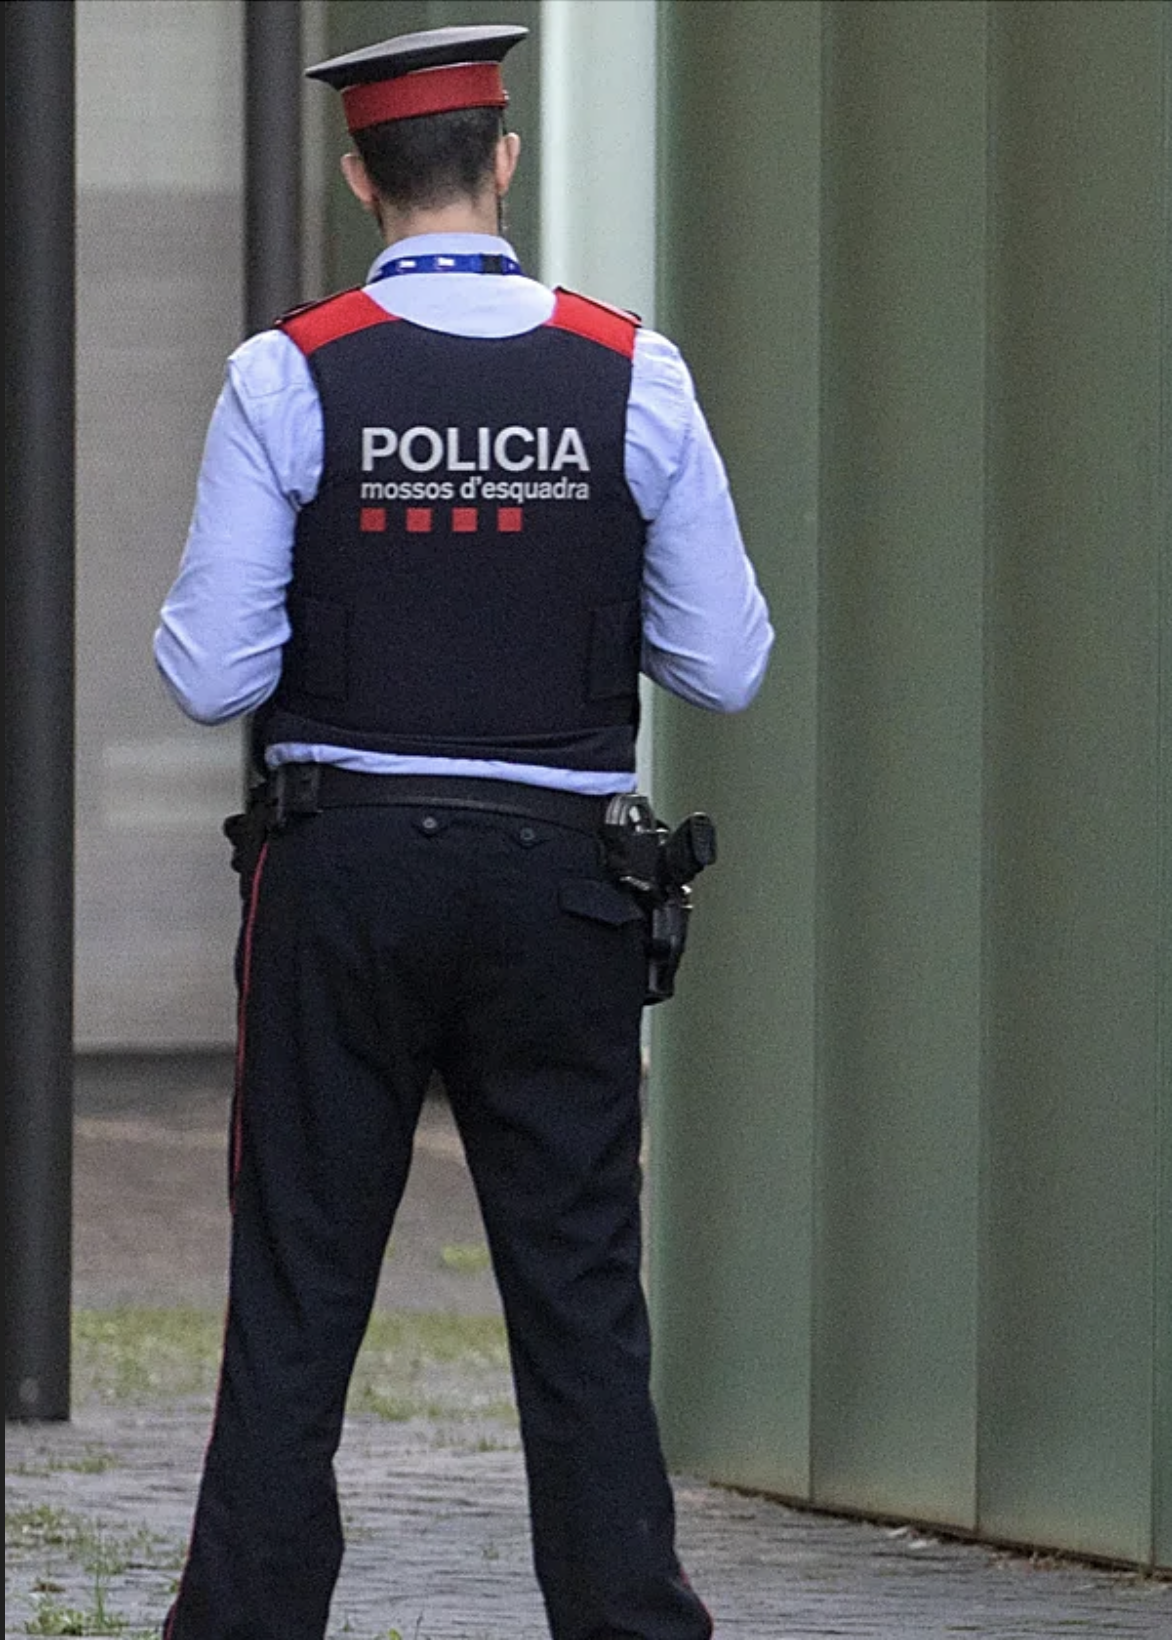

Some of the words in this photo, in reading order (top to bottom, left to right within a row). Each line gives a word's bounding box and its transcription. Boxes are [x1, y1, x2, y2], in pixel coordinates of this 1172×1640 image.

[361, 426, 591, 472] POLICIA
[360, 481, 454, 499] mossos
[460, 476, 590, 503] d'esquadra
